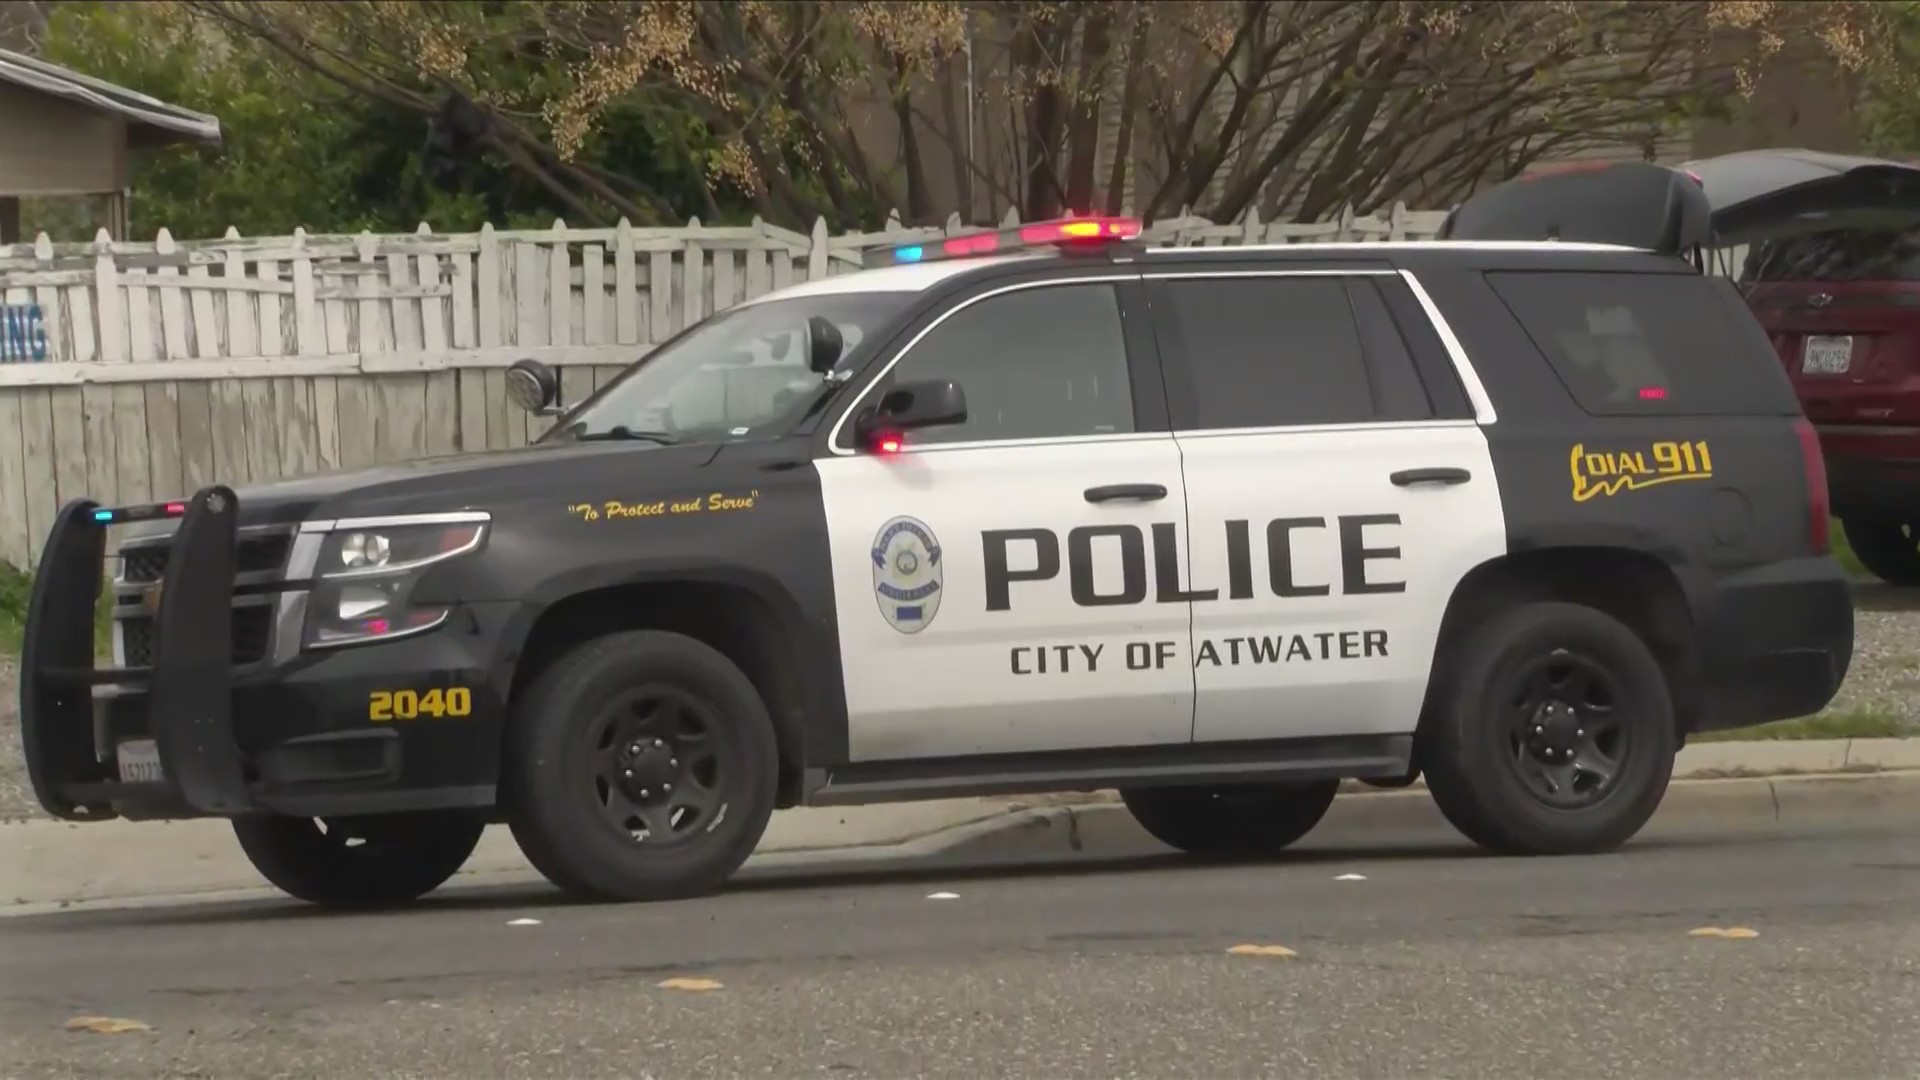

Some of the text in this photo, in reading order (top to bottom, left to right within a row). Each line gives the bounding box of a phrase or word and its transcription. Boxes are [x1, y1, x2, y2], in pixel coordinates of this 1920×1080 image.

[1585, 441, 1713, 475] DIAL 911
[605, 501, 665, 519] Protect
[670, 498, 701, 513] and
[980, 513, 1407, 612] POLICE
[1010, 629, 1389, 675] CITY OF ATWATER
[369, 687, 472, 721] 2040
